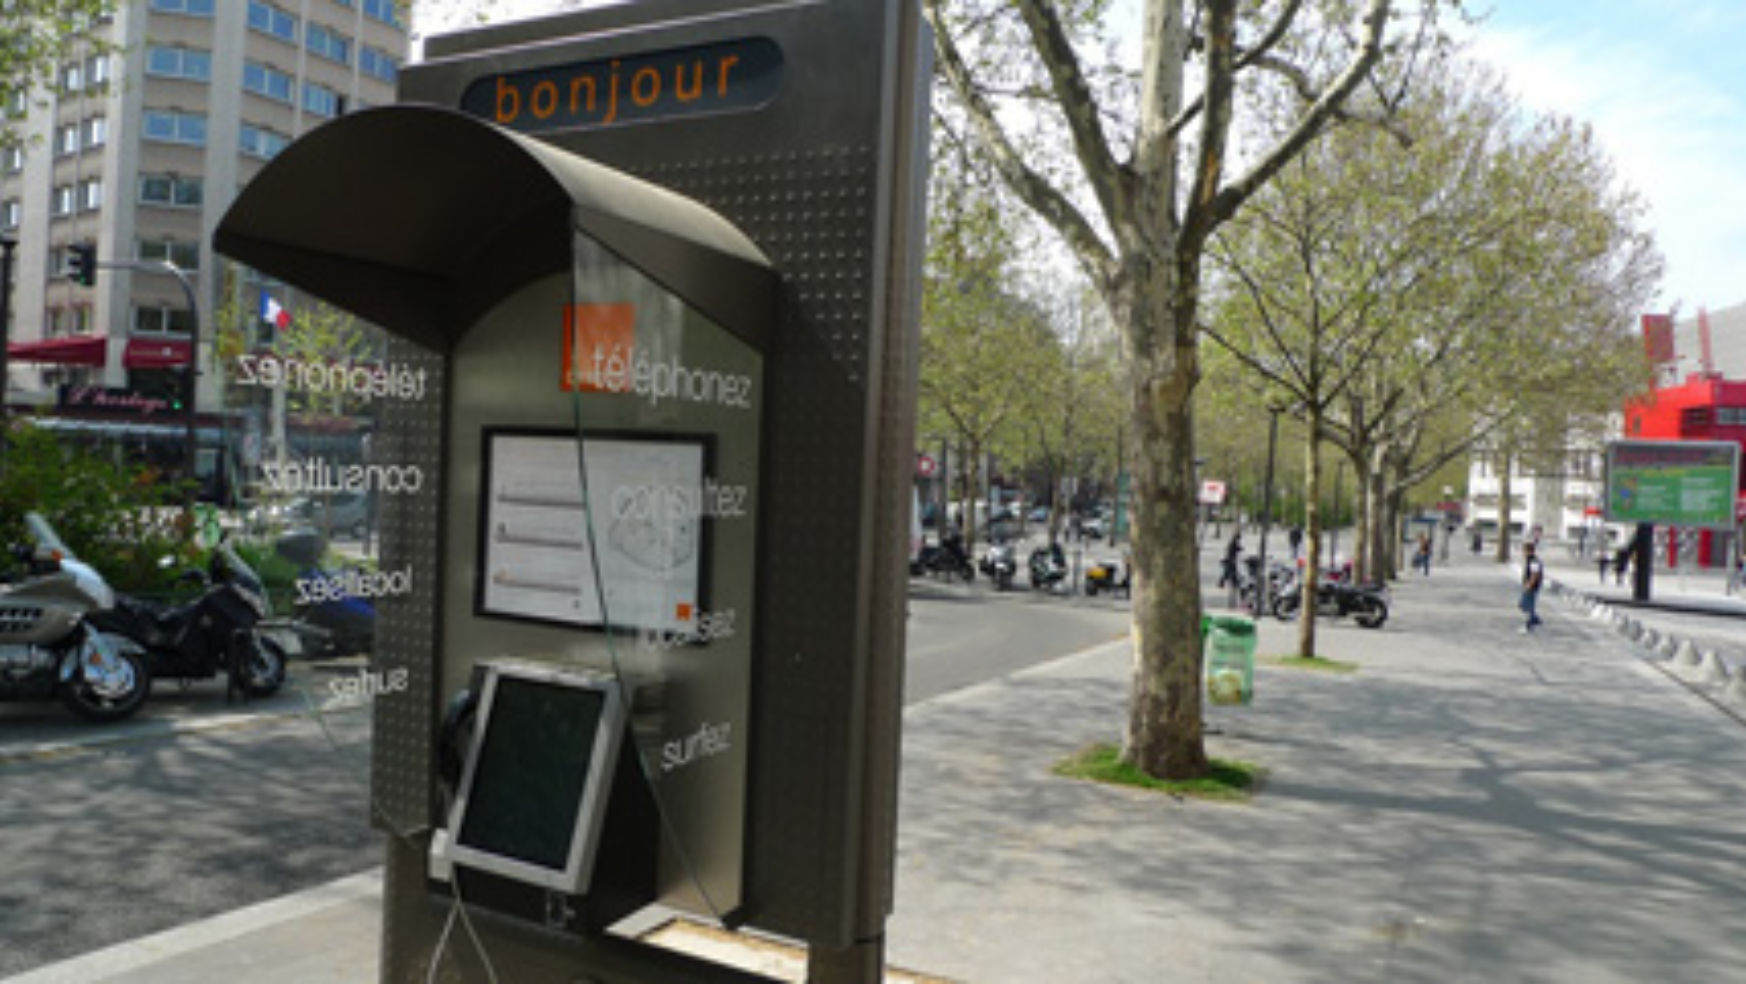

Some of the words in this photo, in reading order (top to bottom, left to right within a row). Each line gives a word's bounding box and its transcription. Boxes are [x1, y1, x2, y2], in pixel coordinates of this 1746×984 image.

[495, 54, 739, 125] bonjour
[592, 344, 751, 408] téléphonez
[660, 721, 732, 772] surfez
